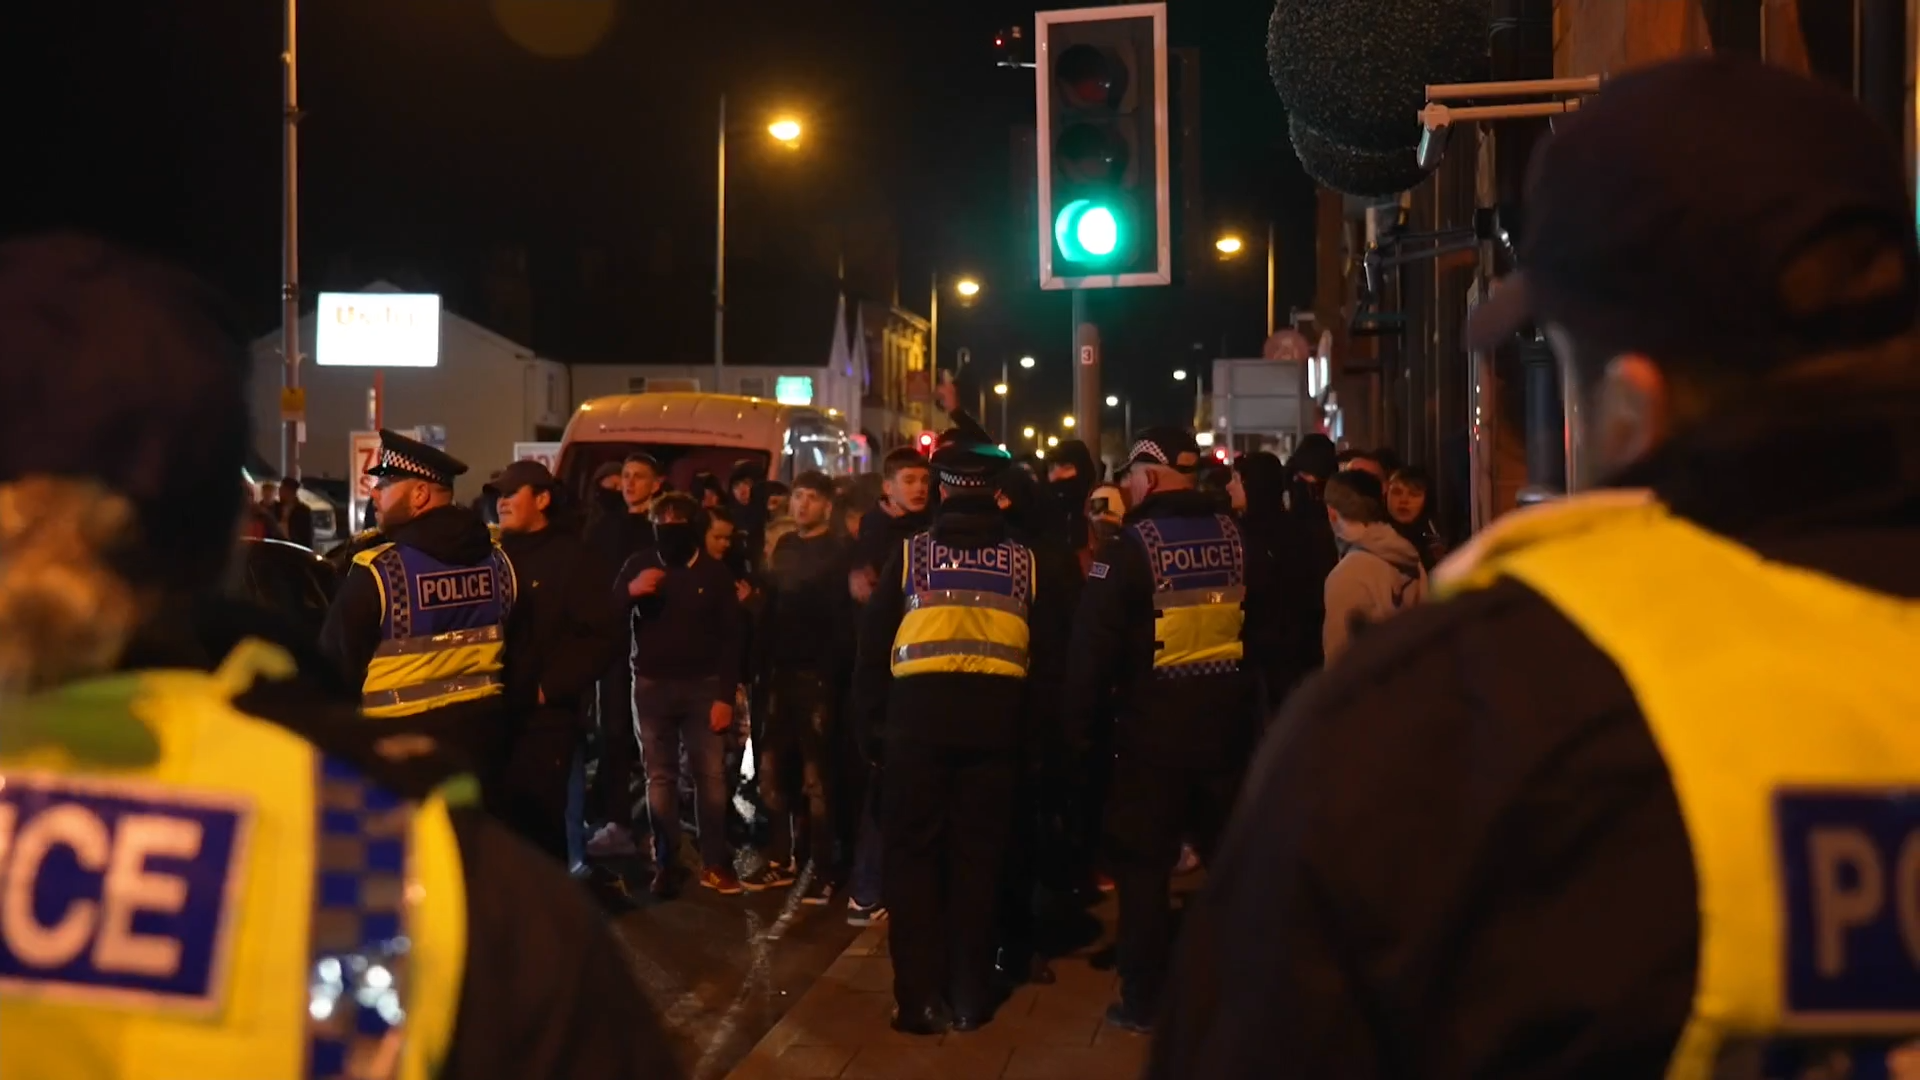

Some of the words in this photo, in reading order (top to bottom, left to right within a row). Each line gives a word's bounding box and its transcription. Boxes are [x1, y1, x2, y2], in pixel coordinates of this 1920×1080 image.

[934, 545, 1009, 570] POLICE
[1161, 545, 1233, 572] POLICE
[422, 573, 492, 603] POLICE
[1806, 826, 1920, 976] P
